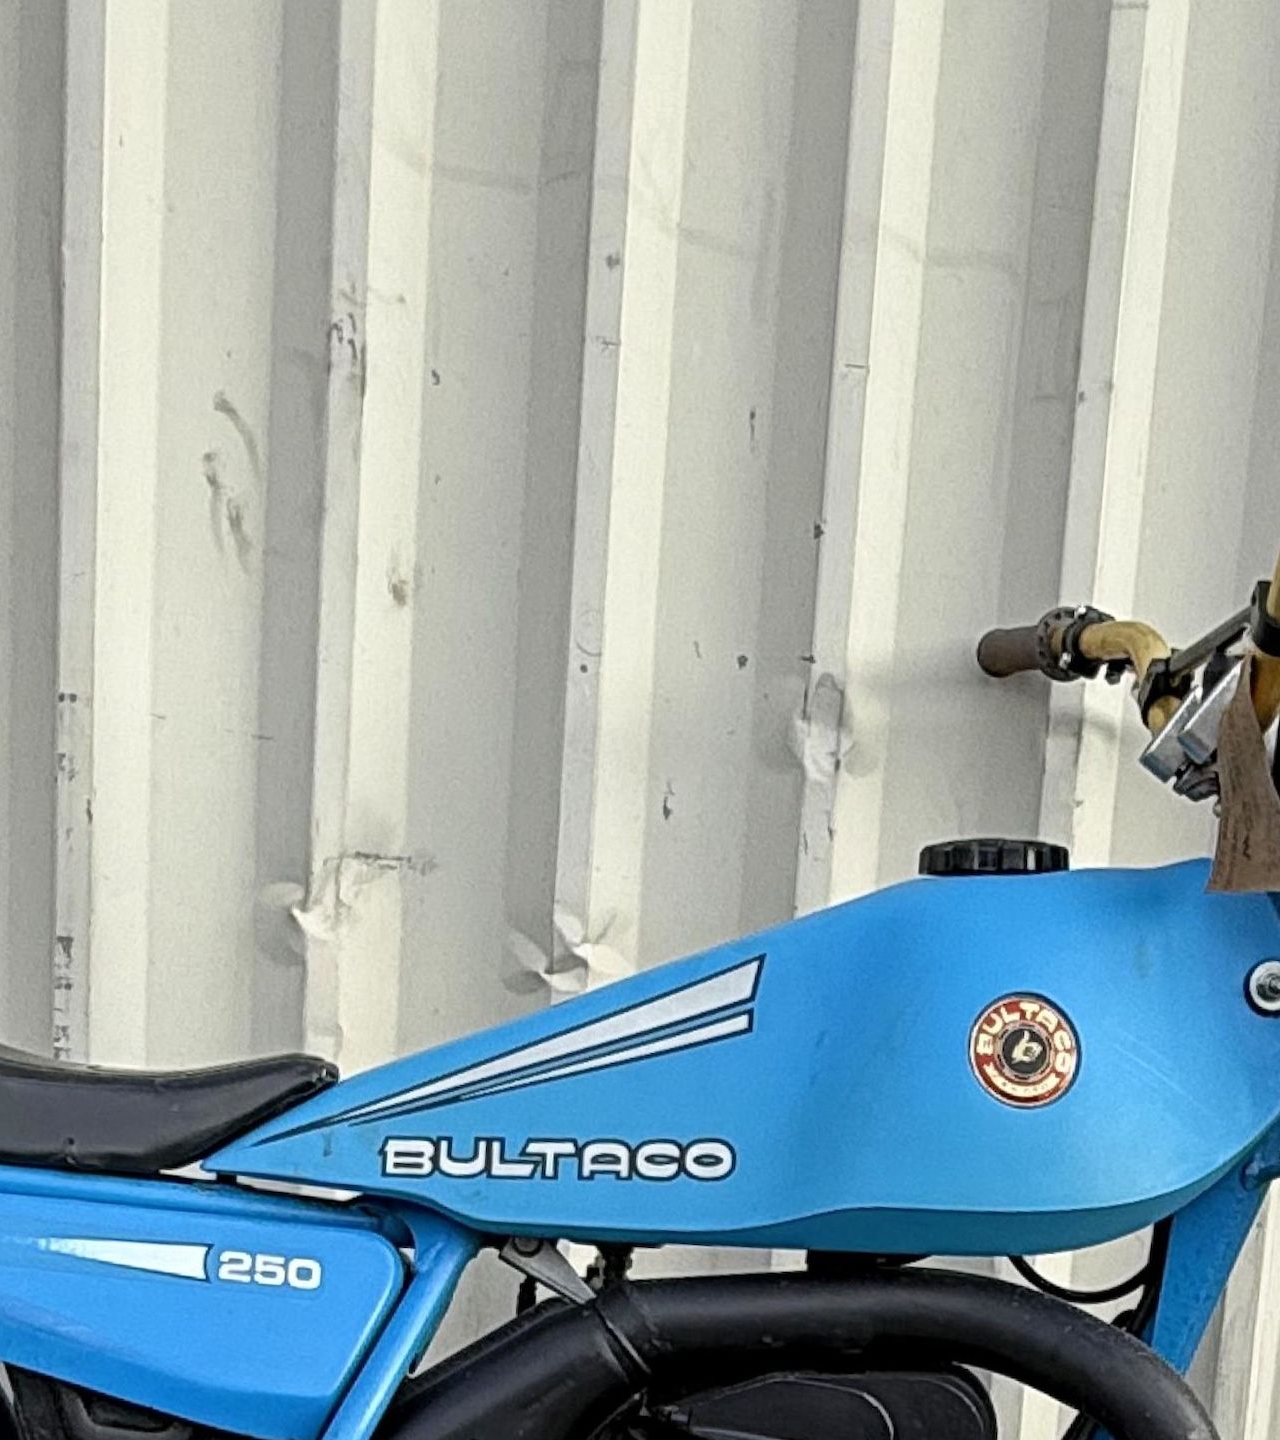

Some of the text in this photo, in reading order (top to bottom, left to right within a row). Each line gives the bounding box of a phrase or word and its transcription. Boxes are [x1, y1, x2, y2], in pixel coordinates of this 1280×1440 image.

[976, 1001, 1072, 1073] BULTACO
[382, 1136, 737, 1181] BULTACO
[218, 1250, 322, 1290] 250
